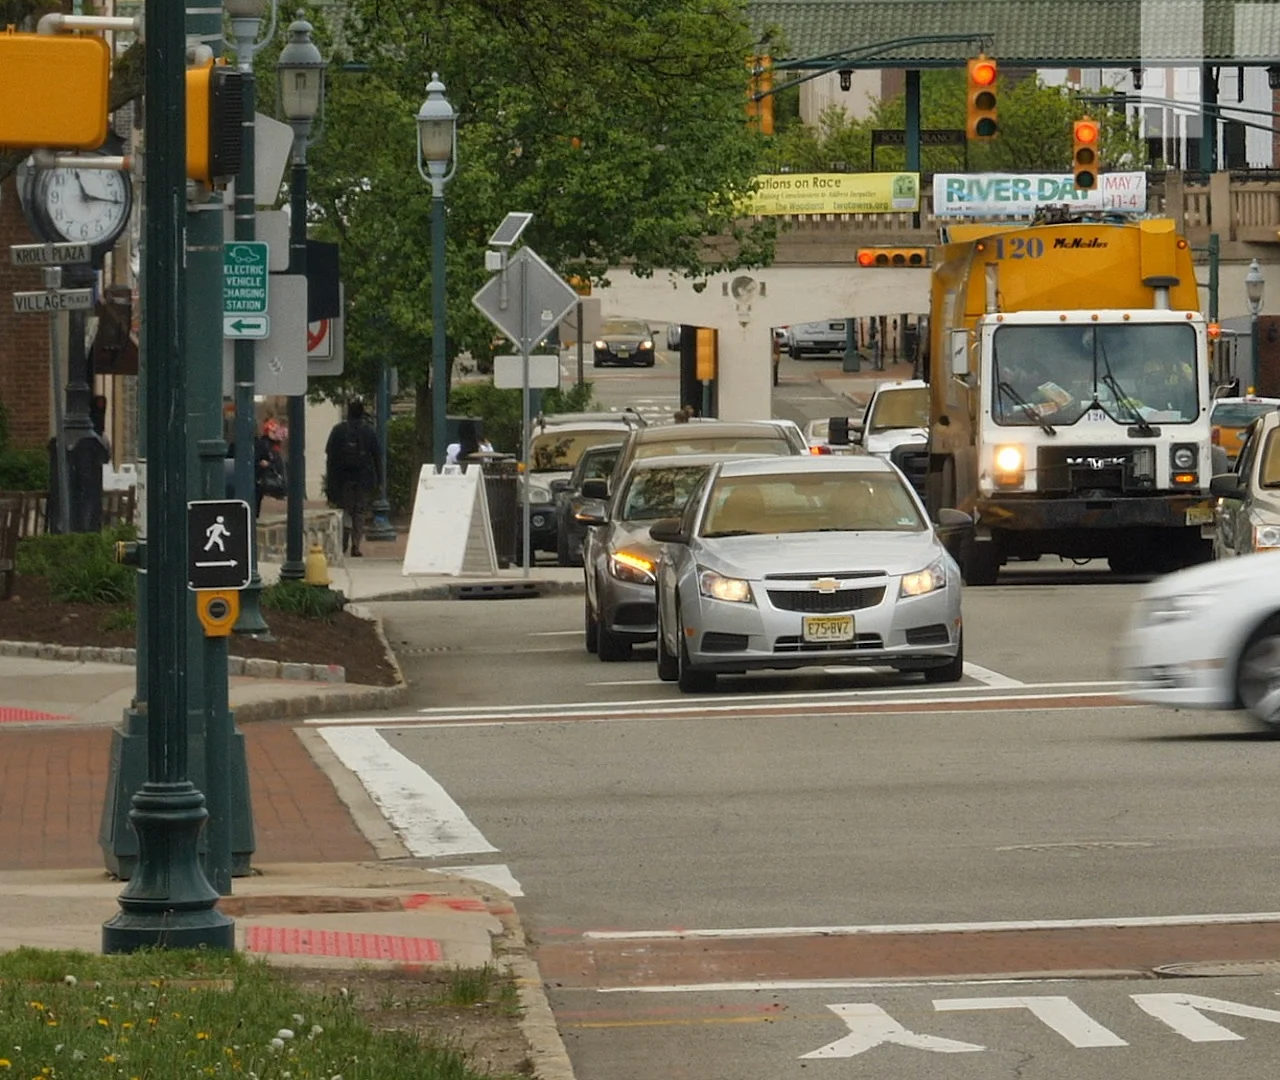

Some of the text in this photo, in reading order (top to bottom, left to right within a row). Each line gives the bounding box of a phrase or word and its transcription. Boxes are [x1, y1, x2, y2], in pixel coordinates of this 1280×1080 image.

[794, 180, 809, 189] on
[812, 176, 842, 188] Race
[946, 177, 1033, 202] RIVER
[1104, 176, 1132, 190] MAY
[1135, 175, 1143, 189] 7
[52, 245, 85, 261] PLAZA
[994, 237, 1044, 260] 120
[223, 264, 264, 275] ELECTRIC
[225, 276, 262, 287] VEHICLE
[223, 288, 265, 299] CHARGING
[15, 292, 89, 311] VILLAGE PLAZA
[225, 300, 261, 310] STATION
[1087, 412, 1106, 422] 120
